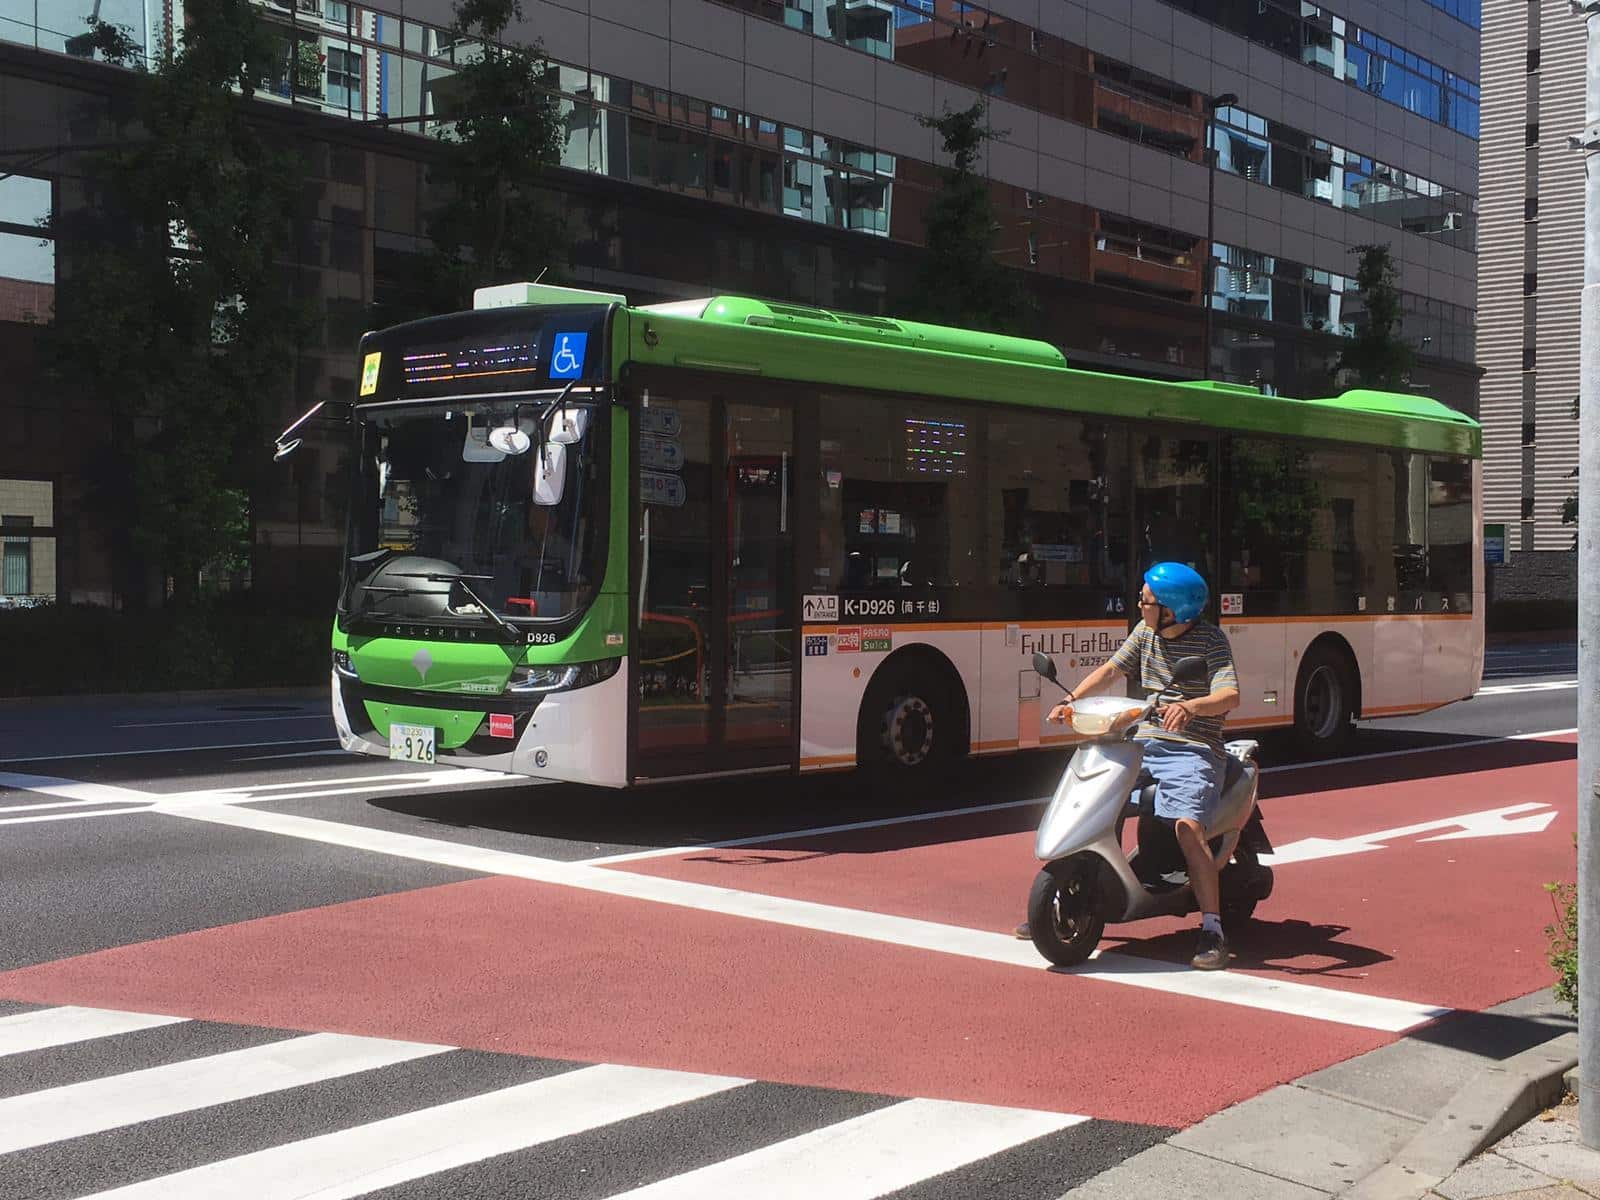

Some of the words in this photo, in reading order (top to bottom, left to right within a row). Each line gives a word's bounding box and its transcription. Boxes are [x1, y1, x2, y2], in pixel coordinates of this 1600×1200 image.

[816, 597, 835, 610] 入口
[844, 599, 896, 615] K-D926
[901, 600, 940, 614] (南千住)
[527, 632, 556, 644] D926
[863, 640, 889, 650] Suica
[405, 737, 433, 761] 926
